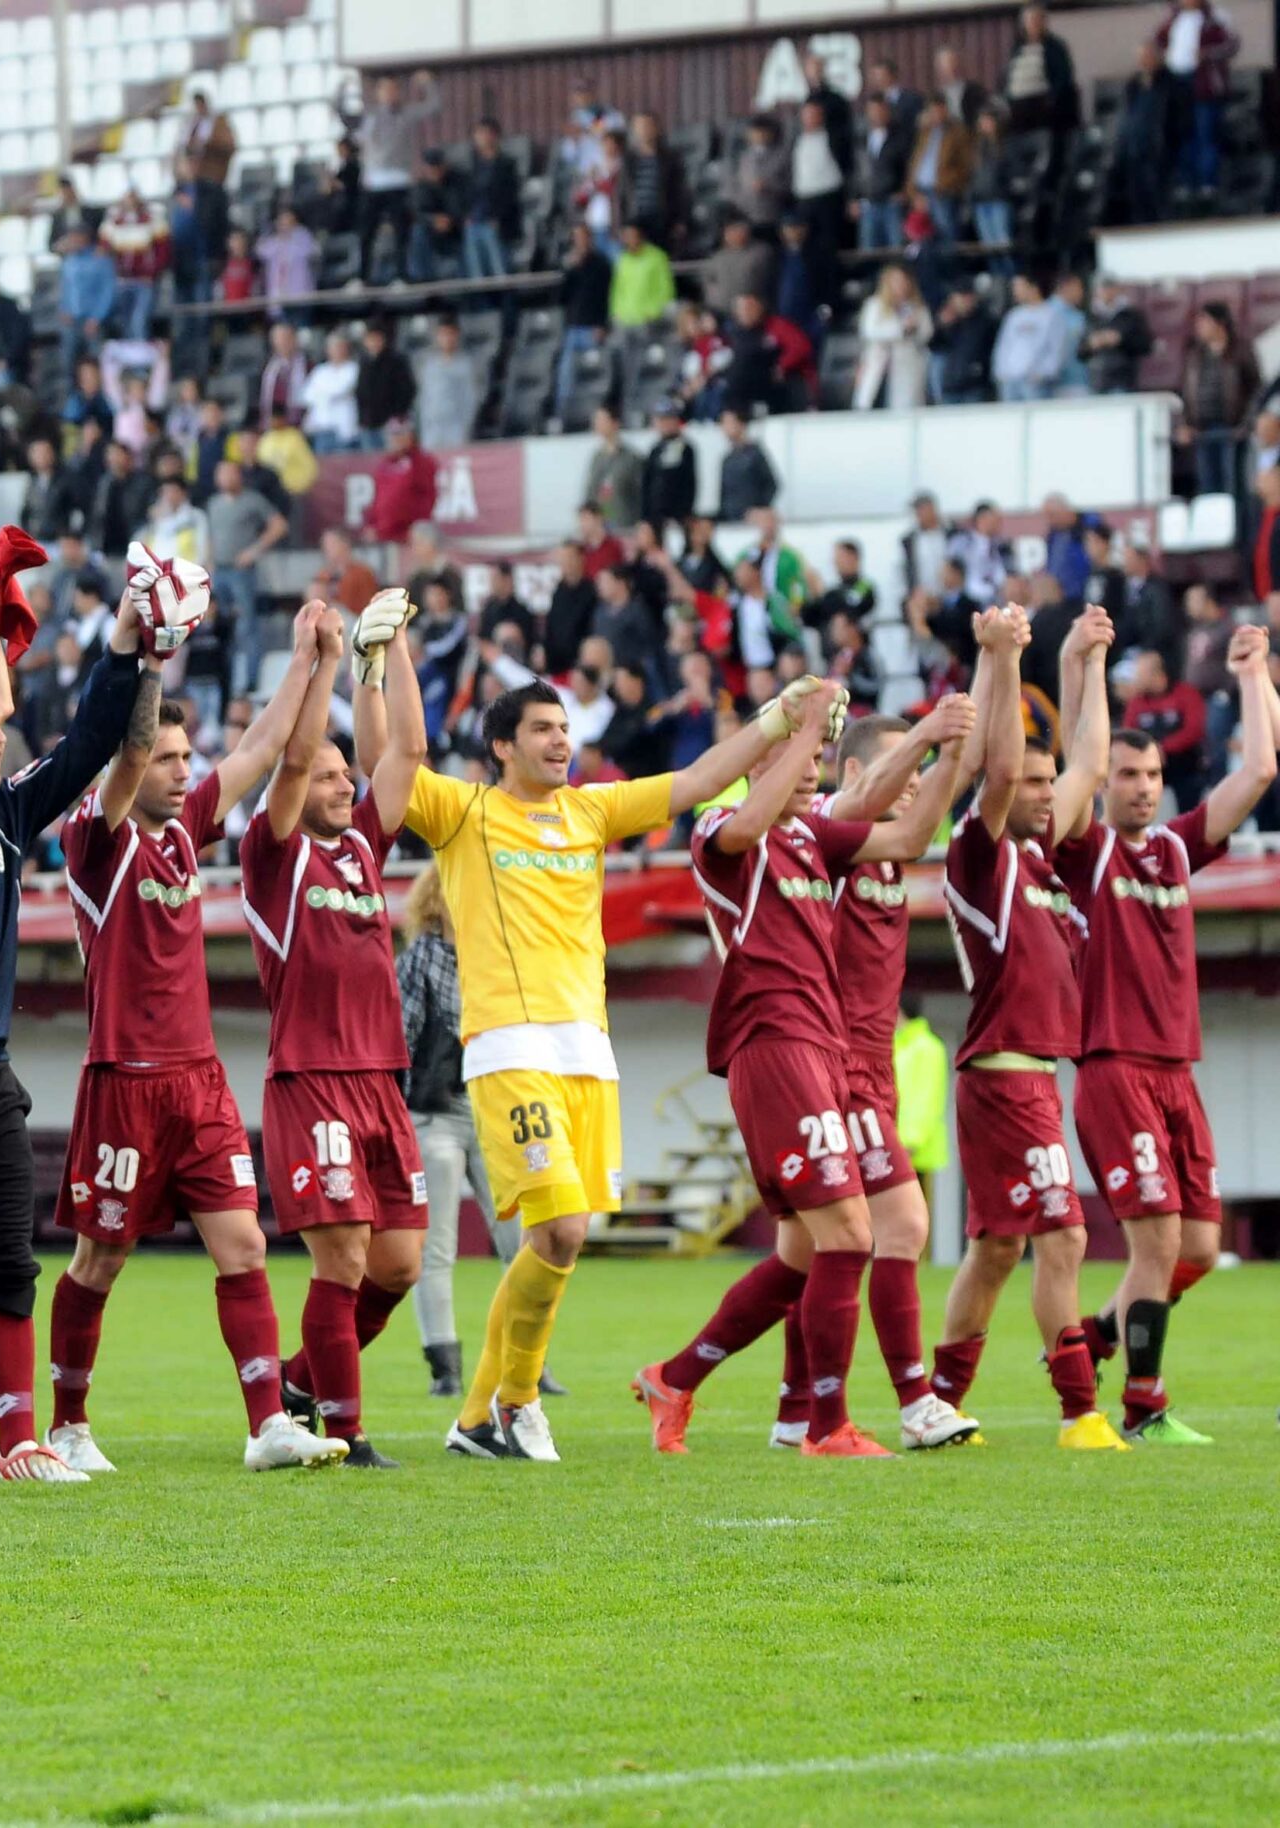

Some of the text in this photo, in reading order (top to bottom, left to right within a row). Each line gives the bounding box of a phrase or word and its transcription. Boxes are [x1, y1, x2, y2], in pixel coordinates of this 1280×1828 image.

[312, 1120, 352, 1166] 16
[510, 1101, 553, 1145] 33
[798, 1110, 848, 1159] 26
[847, 1108, 885, 1154] 11
[95, 1142, 140, 1193] 20
[1025, 1143, 1070, 1190] 30
[1132, 1132, 1159, 1174] 3
